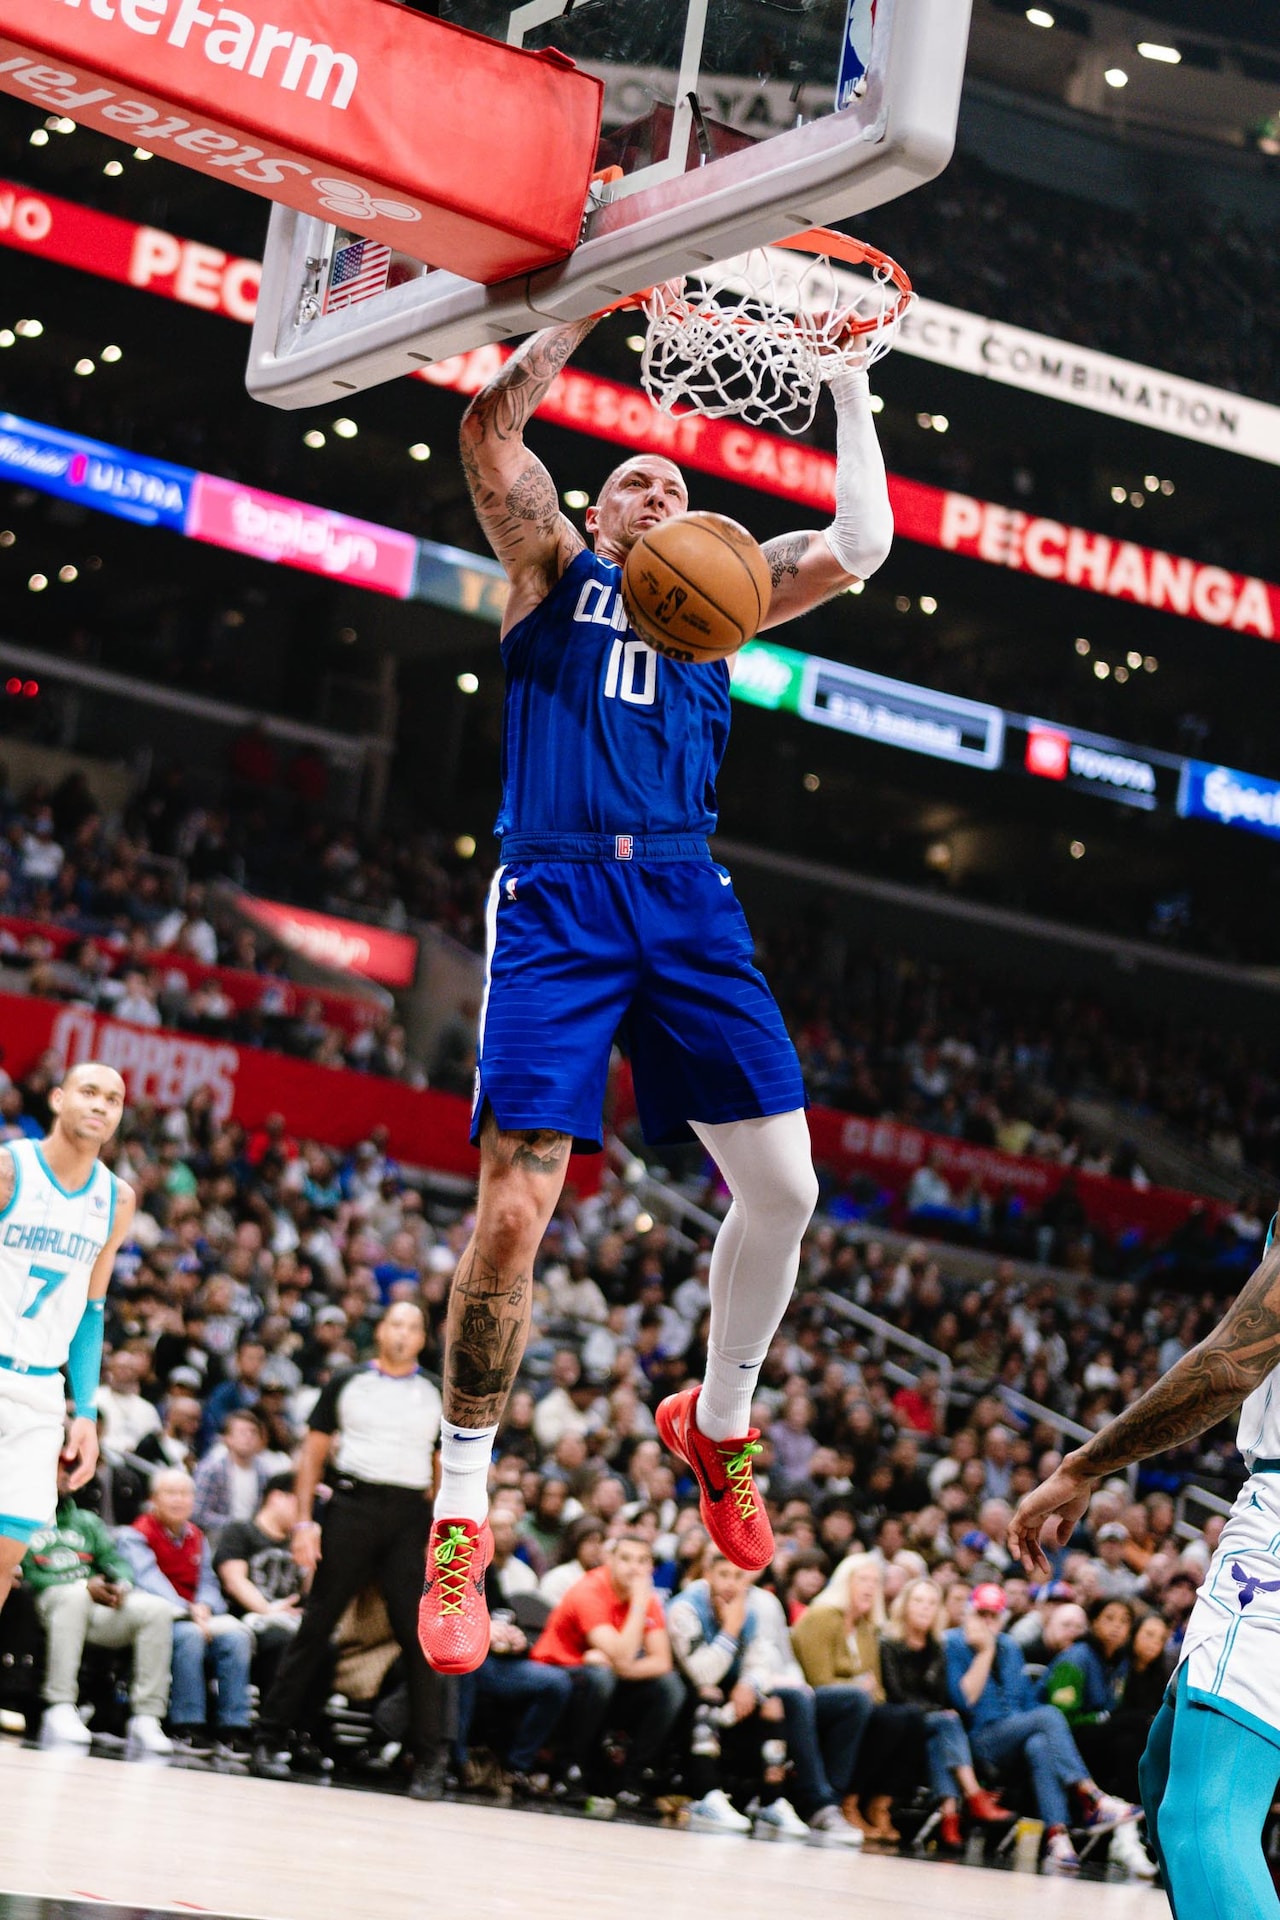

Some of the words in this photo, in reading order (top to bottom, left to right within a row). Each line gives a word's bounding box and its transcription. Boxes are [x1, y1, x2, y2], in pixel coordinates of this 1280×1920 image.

[101, 100, 312, 184] State
[980, 331, 1240, 435] COMBINATION
[87, 459, 184, 513] ULTRA
[940, 489, 1274, 639] PECHANGA
[604, 637, 657, 706] 10
[1069, 743, 1157, 794] TOYOTA
[21, 1264, 69, 1319] 7
